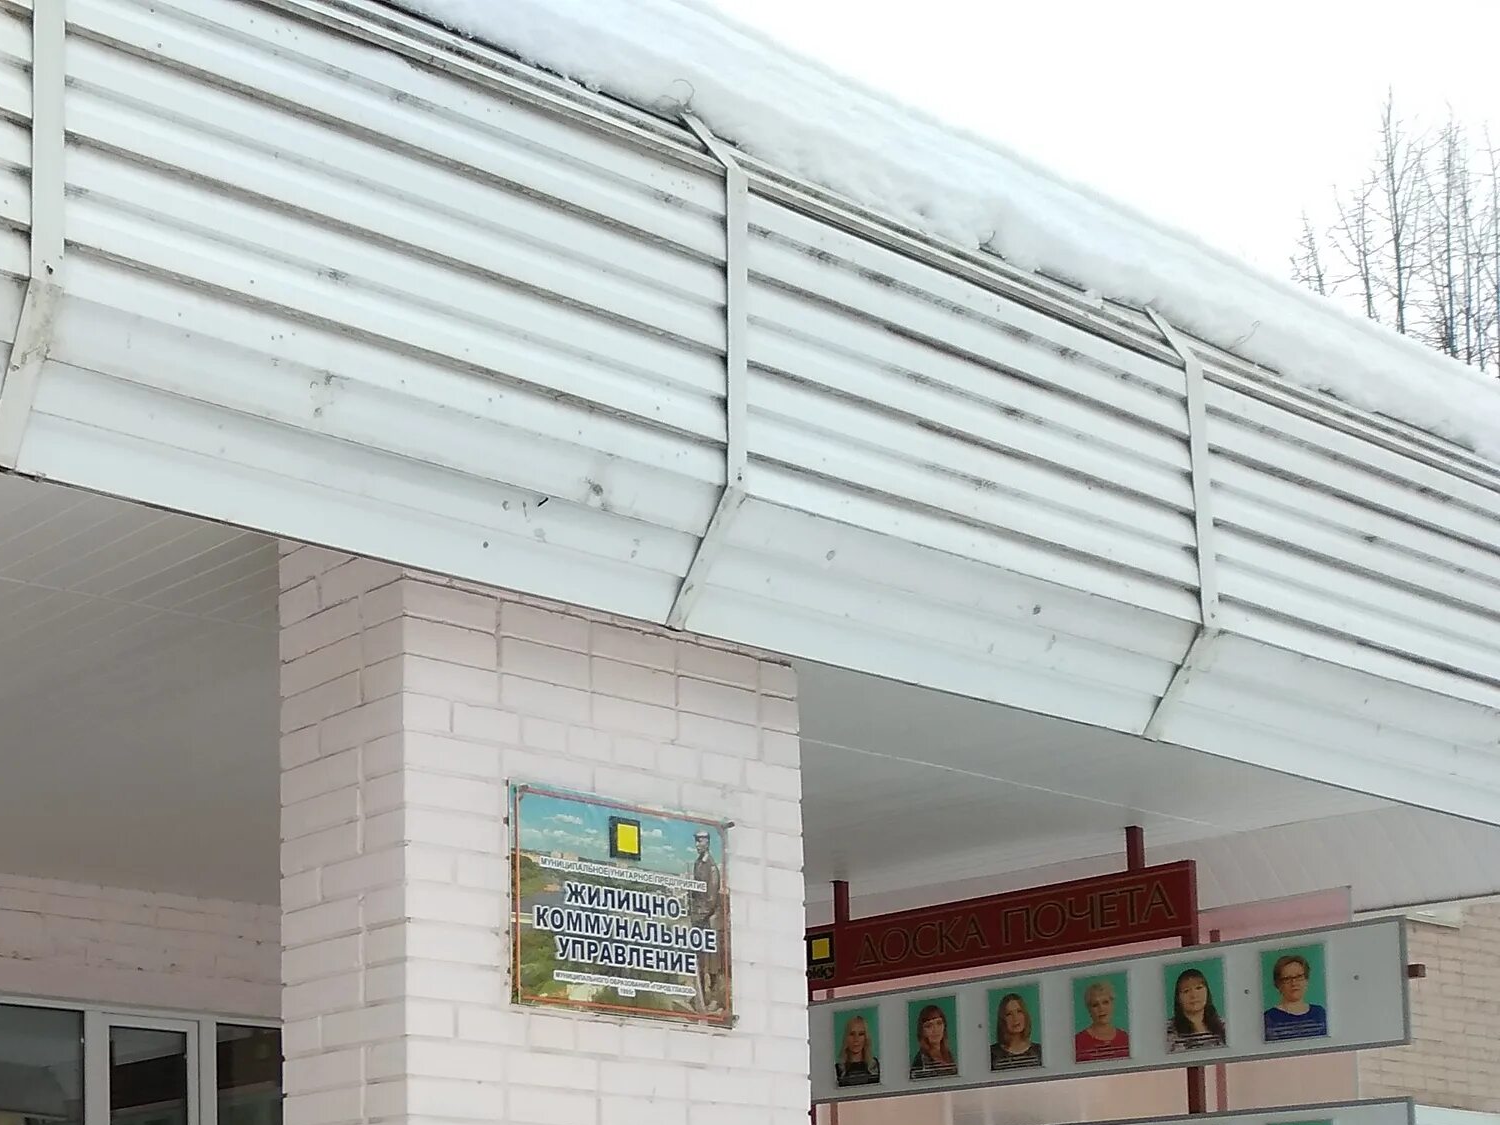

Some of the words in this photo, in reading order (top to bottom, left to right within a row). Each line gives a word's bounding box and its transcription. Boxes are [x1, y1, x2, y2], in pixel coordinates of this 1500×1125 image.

[610, 868, 654, 882] УНИТАРНОЕ
[654, 875, 707, 891] ПРЕДПРИЯТИЕ
[566, 883, 687, 918] ЖИЛИЩНО-
[536, 907, 717, 951] КОММУНАЛЬНОЕ
[855, 912, 991, 968] ДОСКА
[1001, 880, 1177, 946] ПОЧЕТА
[557, 937, 697, 974] УПРАВЛЕНИЕ
